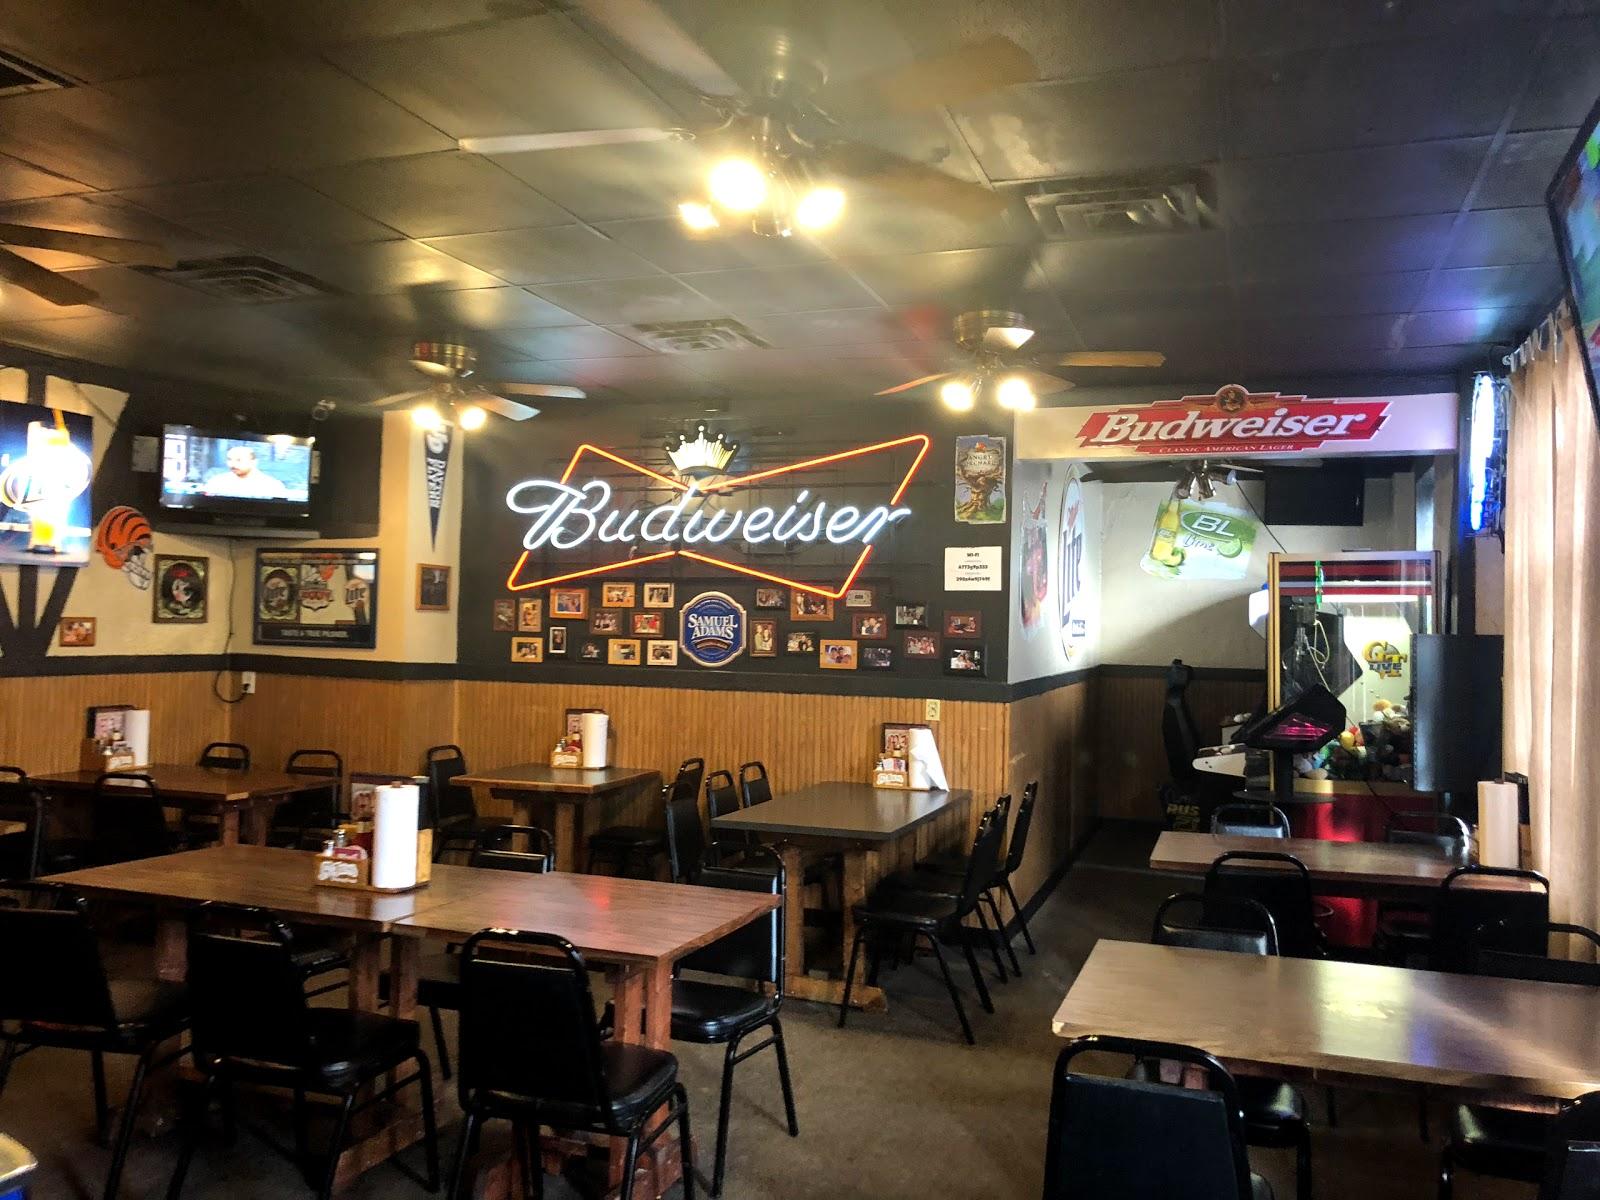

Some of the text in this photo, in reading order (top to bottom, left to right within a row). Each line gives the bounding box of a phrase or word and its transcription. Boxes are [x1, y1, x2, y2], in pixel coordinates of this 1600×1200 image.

[1090, 408, 1366, 442] Budweiser
[506, 480, 912, 550] Budweiser
[1192, 514, 1235, 537] BL
[1061, 526, 1083, 628] Lite
[688, 613, 738, 628] SAMUEL
[691, 625, 734, 640] ADAMS
